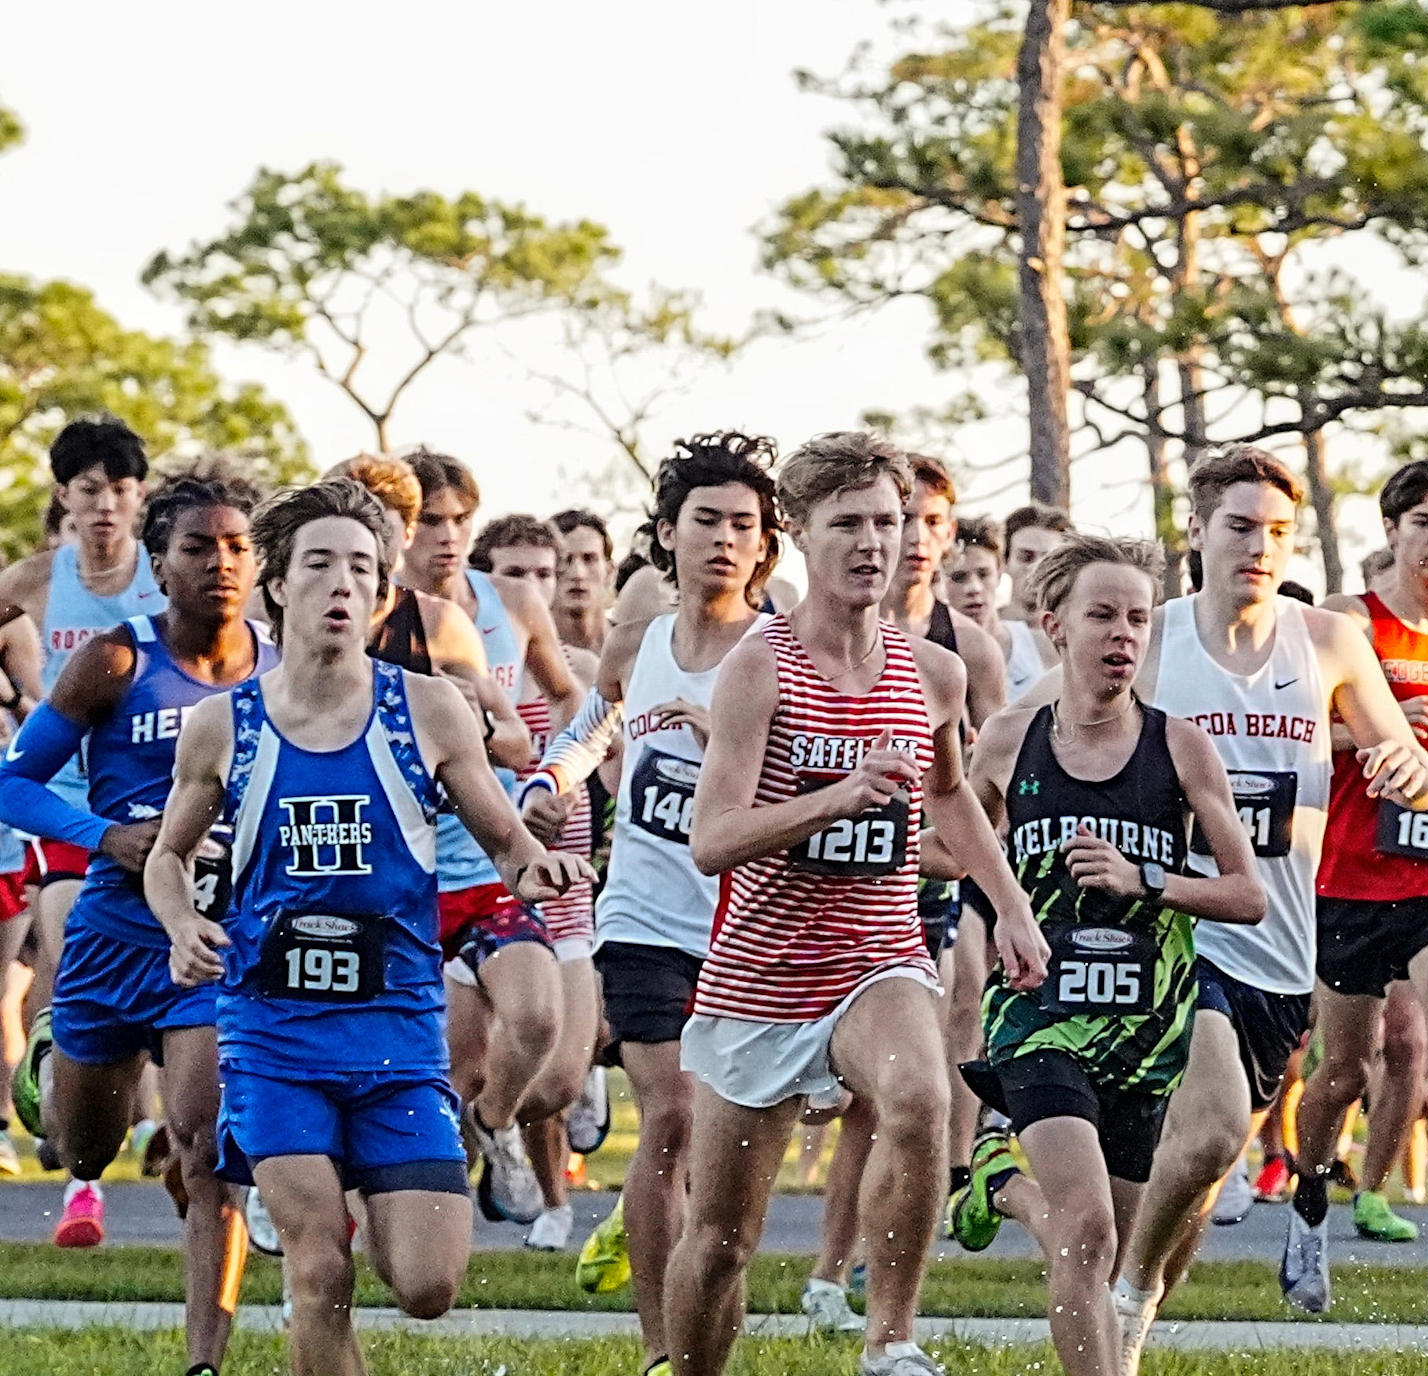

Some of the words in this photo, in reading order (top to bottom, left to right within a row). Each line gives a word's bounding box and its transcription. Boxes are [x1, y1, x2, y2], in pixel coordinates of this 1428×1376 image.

[1245, 714, 1316, 743] BEACH
[279, 823, 372, 847] PANTHERS
[807, 818, 895, 864] 1213
[285, 947, 361, 993] 193
[1058, 960, 1142, 1005] 205
